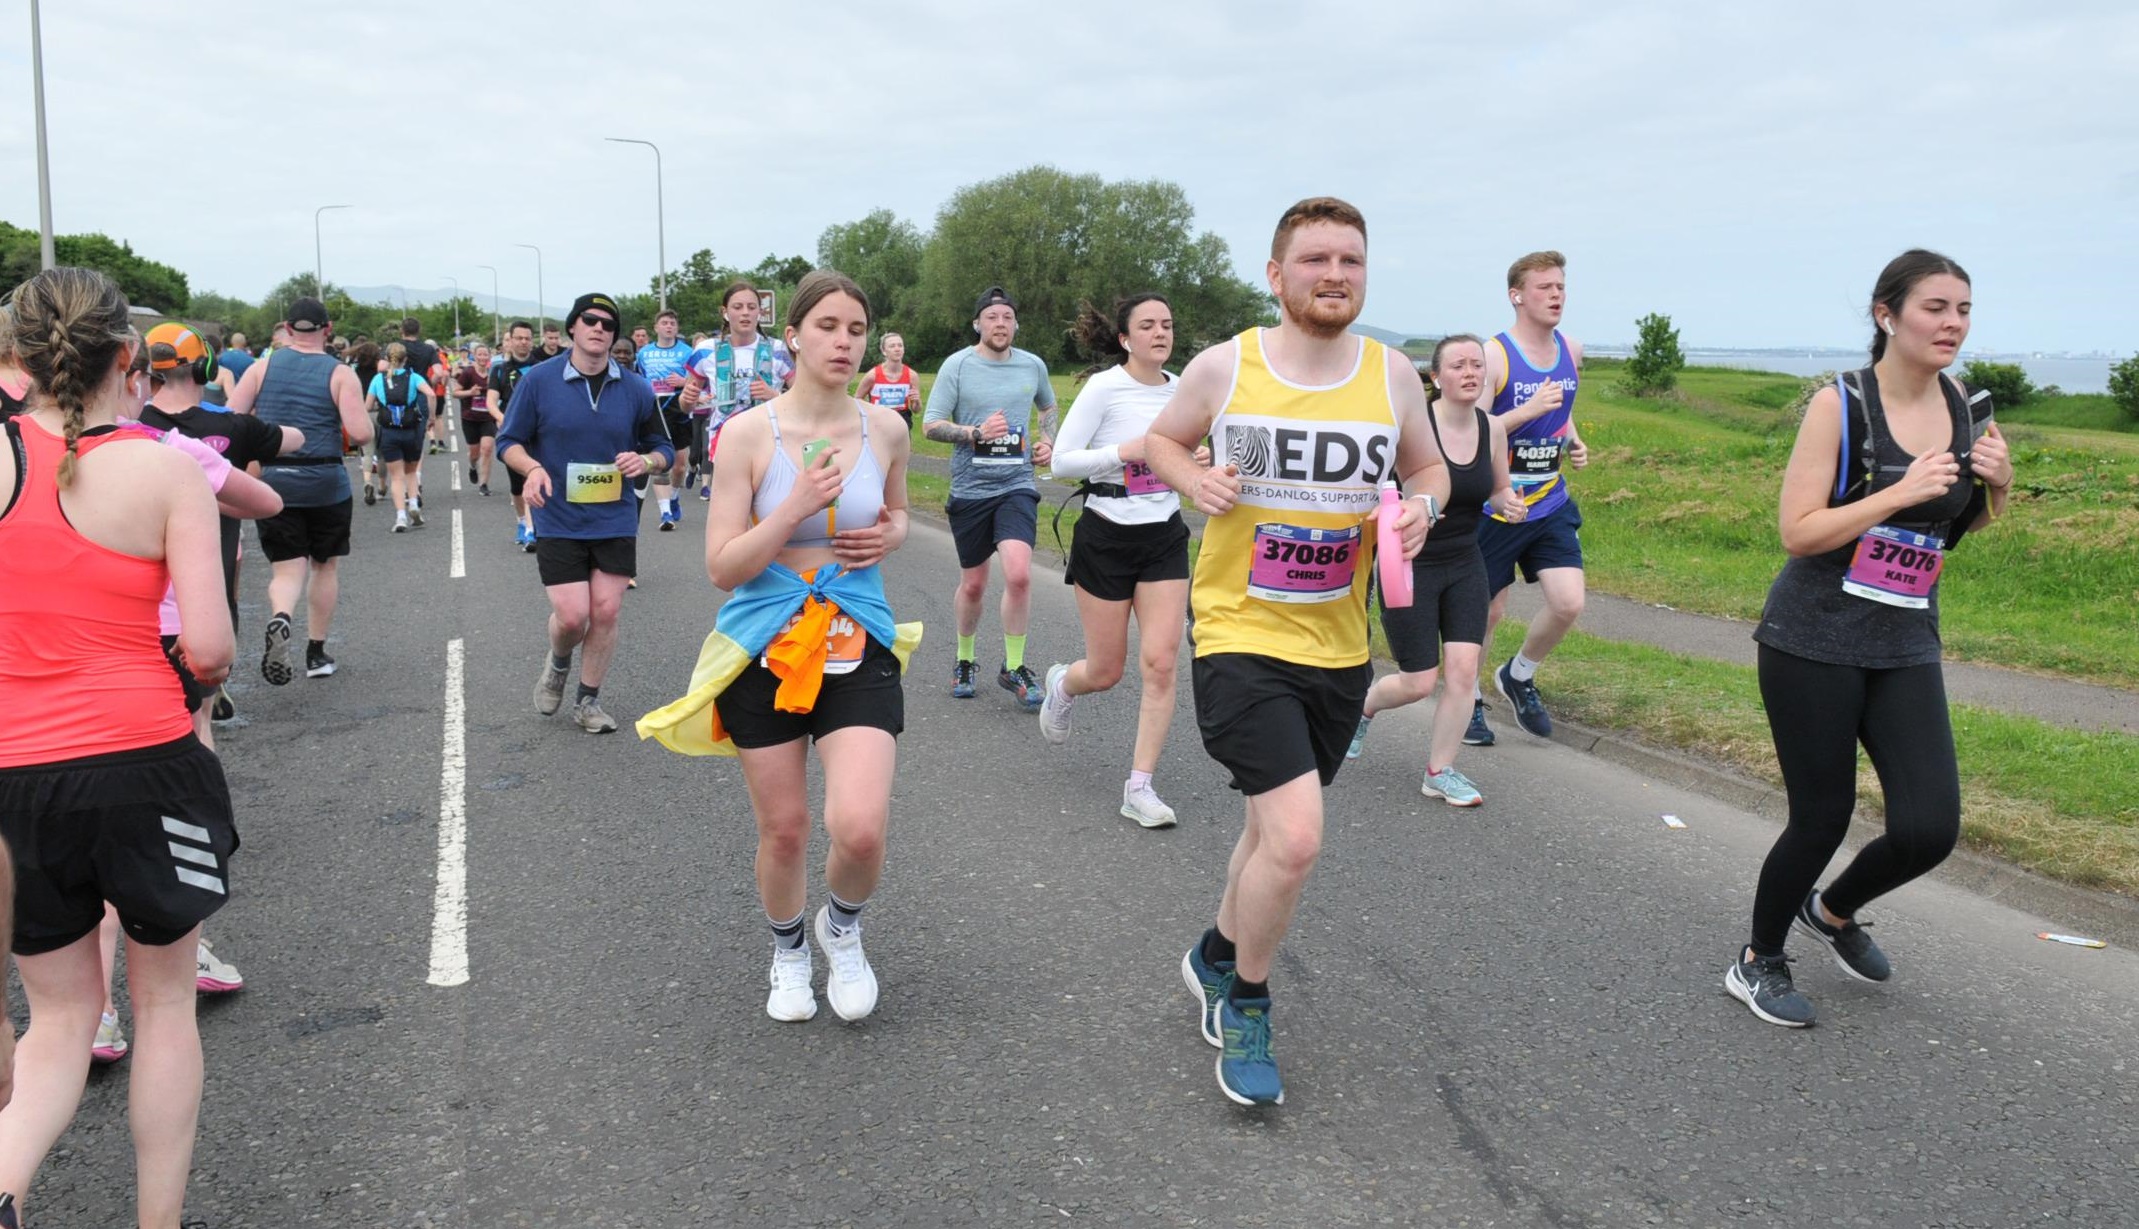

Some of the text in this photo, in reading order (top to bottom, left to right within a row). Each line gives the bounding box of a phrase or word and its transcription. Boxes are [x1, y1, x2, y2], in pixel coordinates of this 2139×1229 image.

[1275, 428, 1388, 484] EDS
[1517, 446, 1558, 460] 40375
[577, 475, 613, 484] 95643
[1241, 484, 1317, 502] ERS-DANLOS
[1321, 491, 1368, 504] SUPPORT
[1263, 538, 1350, 565] 37086
[1868, 540, 1937, 572] 37076
[1286, 569, 1326, 580] CHRIS
[1885, 569, 1917, 585] KATIE
